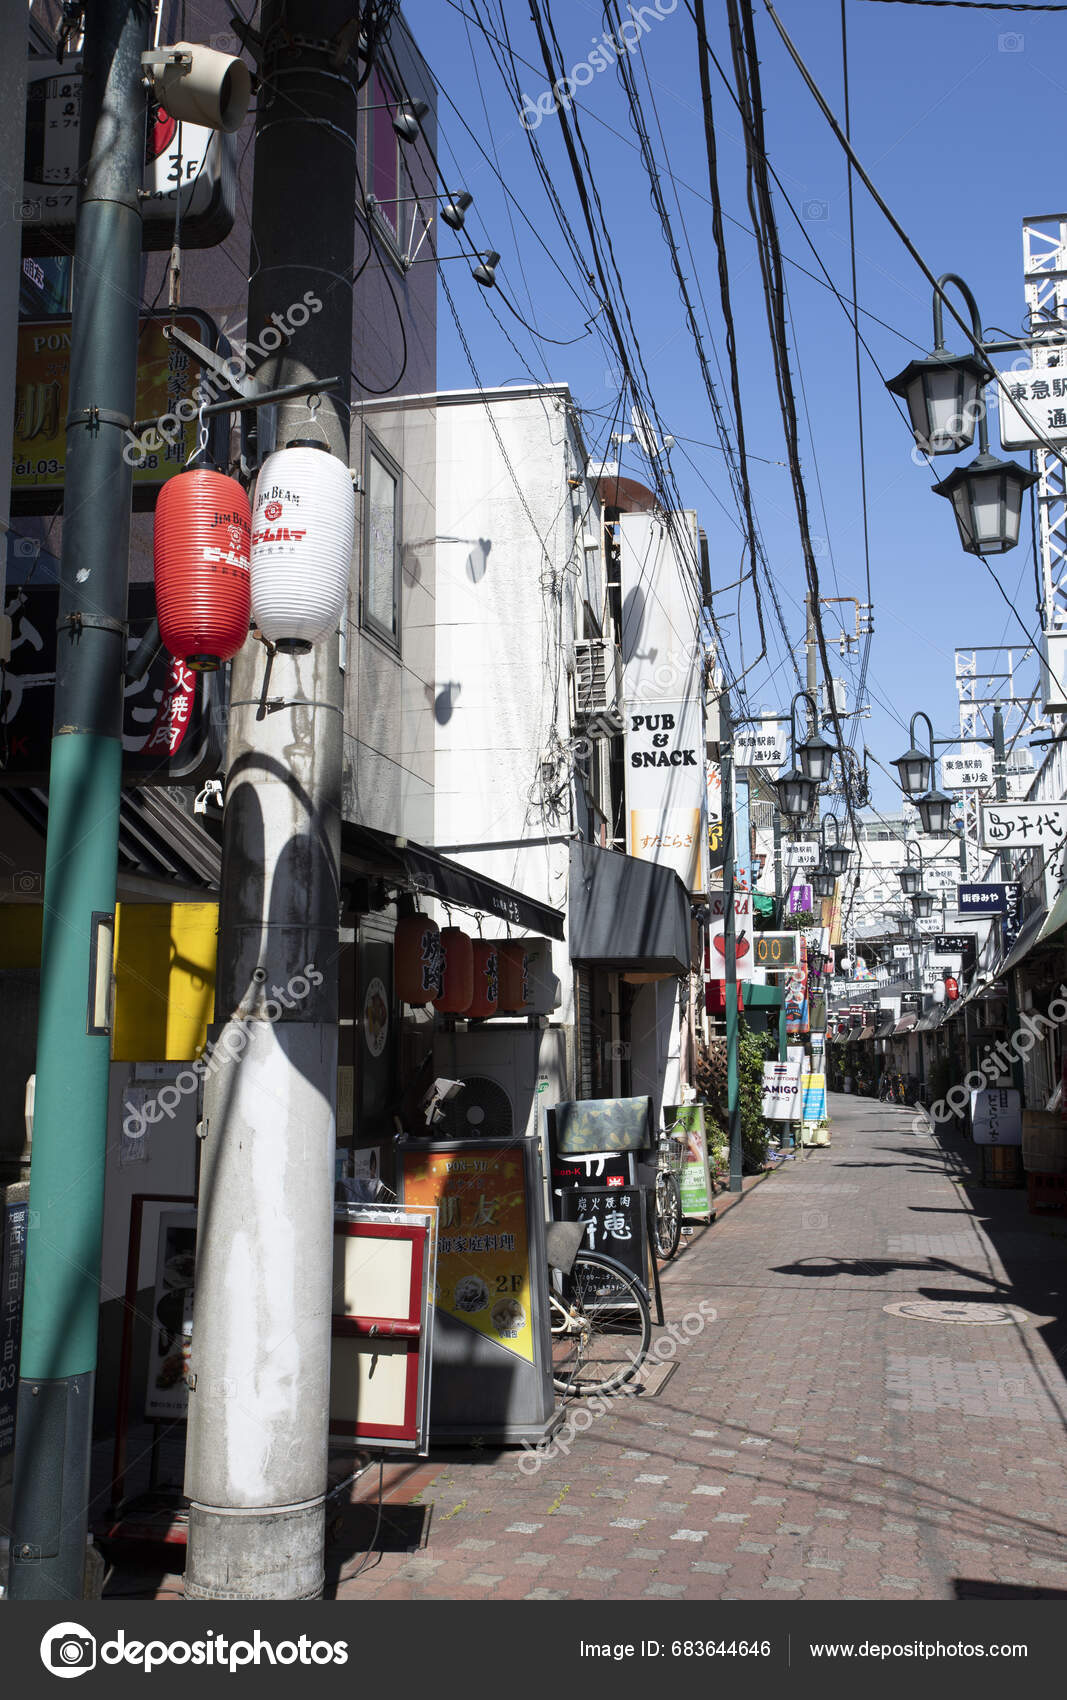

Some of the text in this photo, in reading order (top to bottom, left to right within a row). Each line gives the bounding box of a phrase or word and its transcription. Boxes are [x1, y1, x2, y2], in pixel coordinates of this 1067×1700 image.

[13, 459, 64, 475] el.03-
[272, 486, 300, 507] BEAM
[211, 512, 231, 527] JIM
[149, 656, 193, 751] 火焼肉
[631, 714, 675, 732] PUB
[652, 733, 669, 748] &
[738, 736, 776, 747] 東急駅前
[631, 750, 697, 768] SNACK
[755, 750, 782, 761] 通り会
[945, 759, 983, 770] 東急駅前
[962, 773, 988, 783] 通り会
[640, 834, 692, 848] すたこらさ
[764, 1085, 799, 1094] AMIGO
[495, 1274, 523, 1292] 2F
